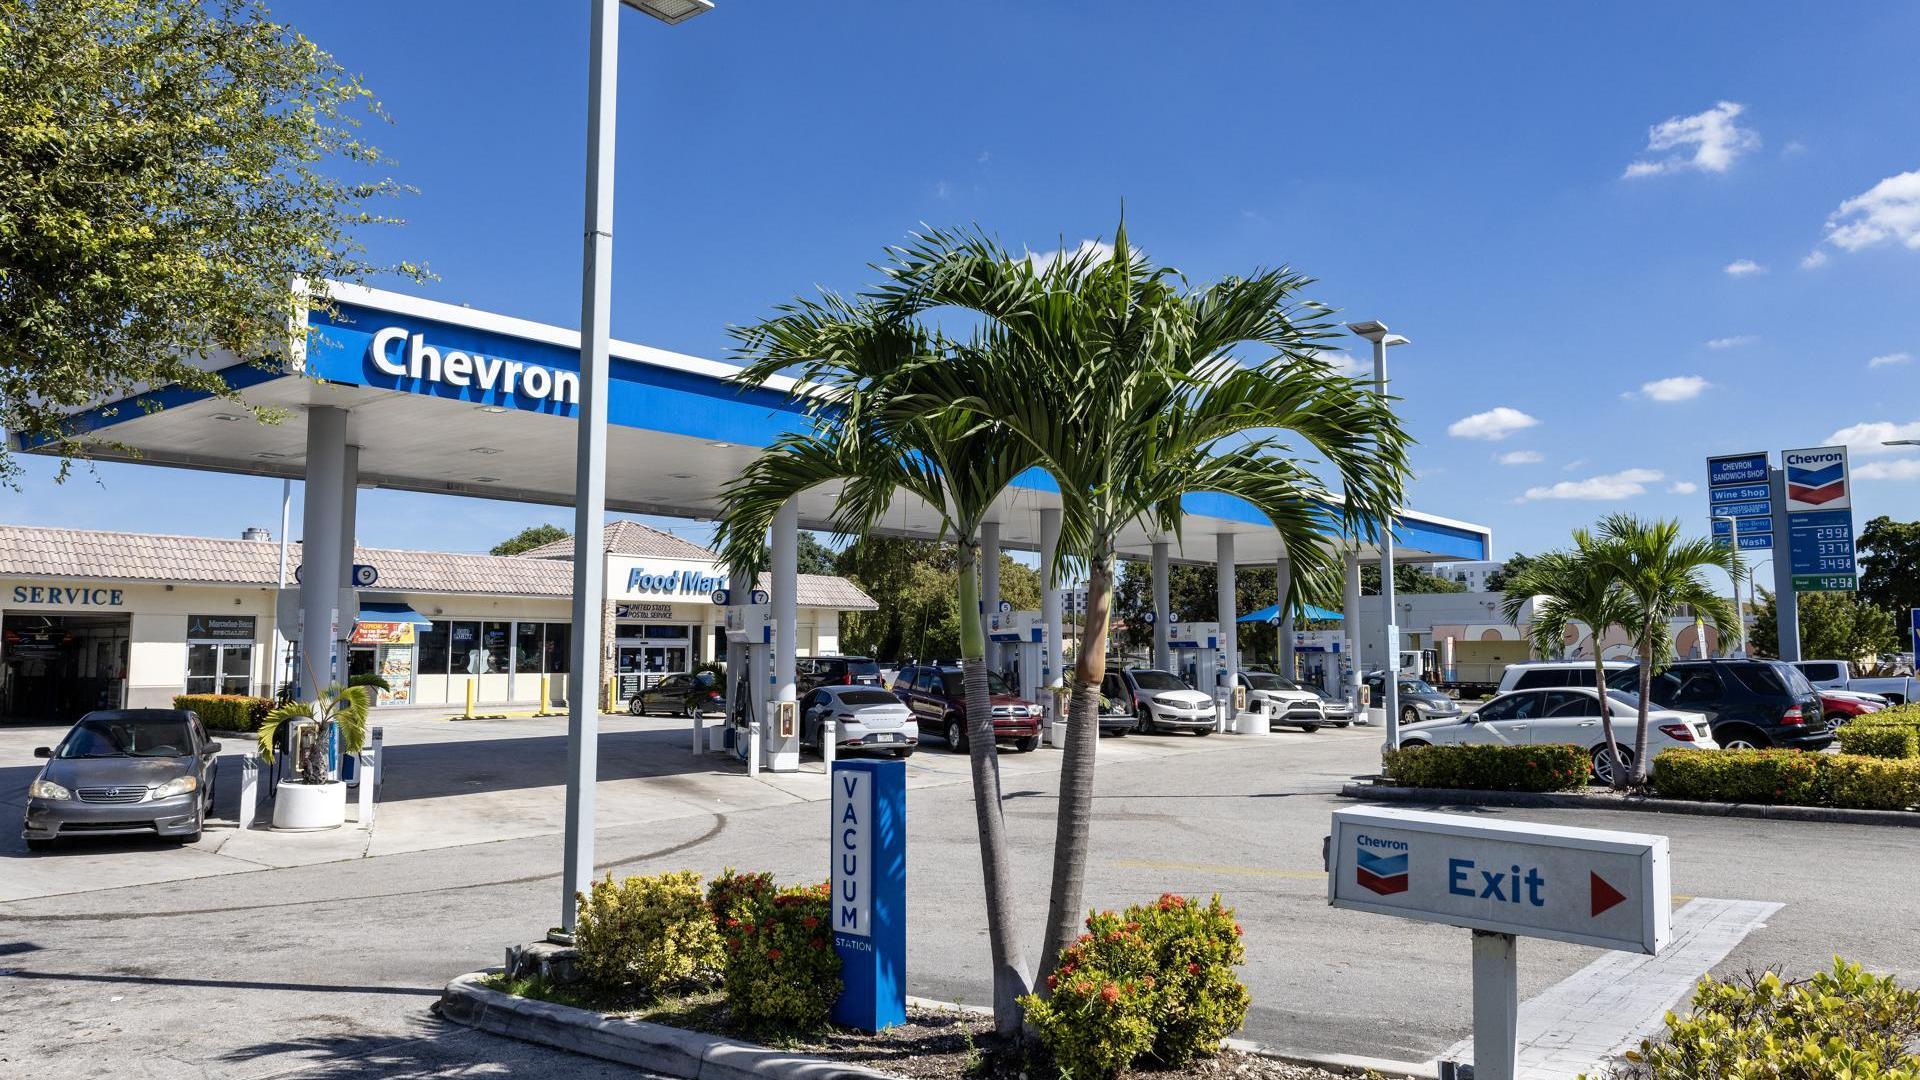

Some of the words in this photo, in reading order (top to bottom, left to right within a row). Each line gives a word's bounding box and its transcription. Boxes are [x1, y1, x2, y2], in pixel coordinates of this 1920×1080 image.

[371, 326, 580, 404] Chevron
[1786, 453, 1842, 465] Chevron
[1722, 461, 1752, 471] CHEVRON
[1713, 471, 1746, 481] SANDWICH
[1747, 469, 1764, 479] SHOP
[1715, 491, 1738, 499] Wine
[1741, 488, 1765, 499] Shop
[1740, 538, 1766, 546] Wash
[363, 570, 371, 580] 9
[628, 567, 680, 591] Food
[13, 586, 123, 605] SERVICE
[629, 604, 651, 612] UNITED
[651, 604, 672, 612] STATES
[1356, 834, 1409, 851] Chevron
[841, 776, 858, 929] VACUUM
[1448, 857, 1545, 907] Exit
[835, 937, 871, 952] STATION
